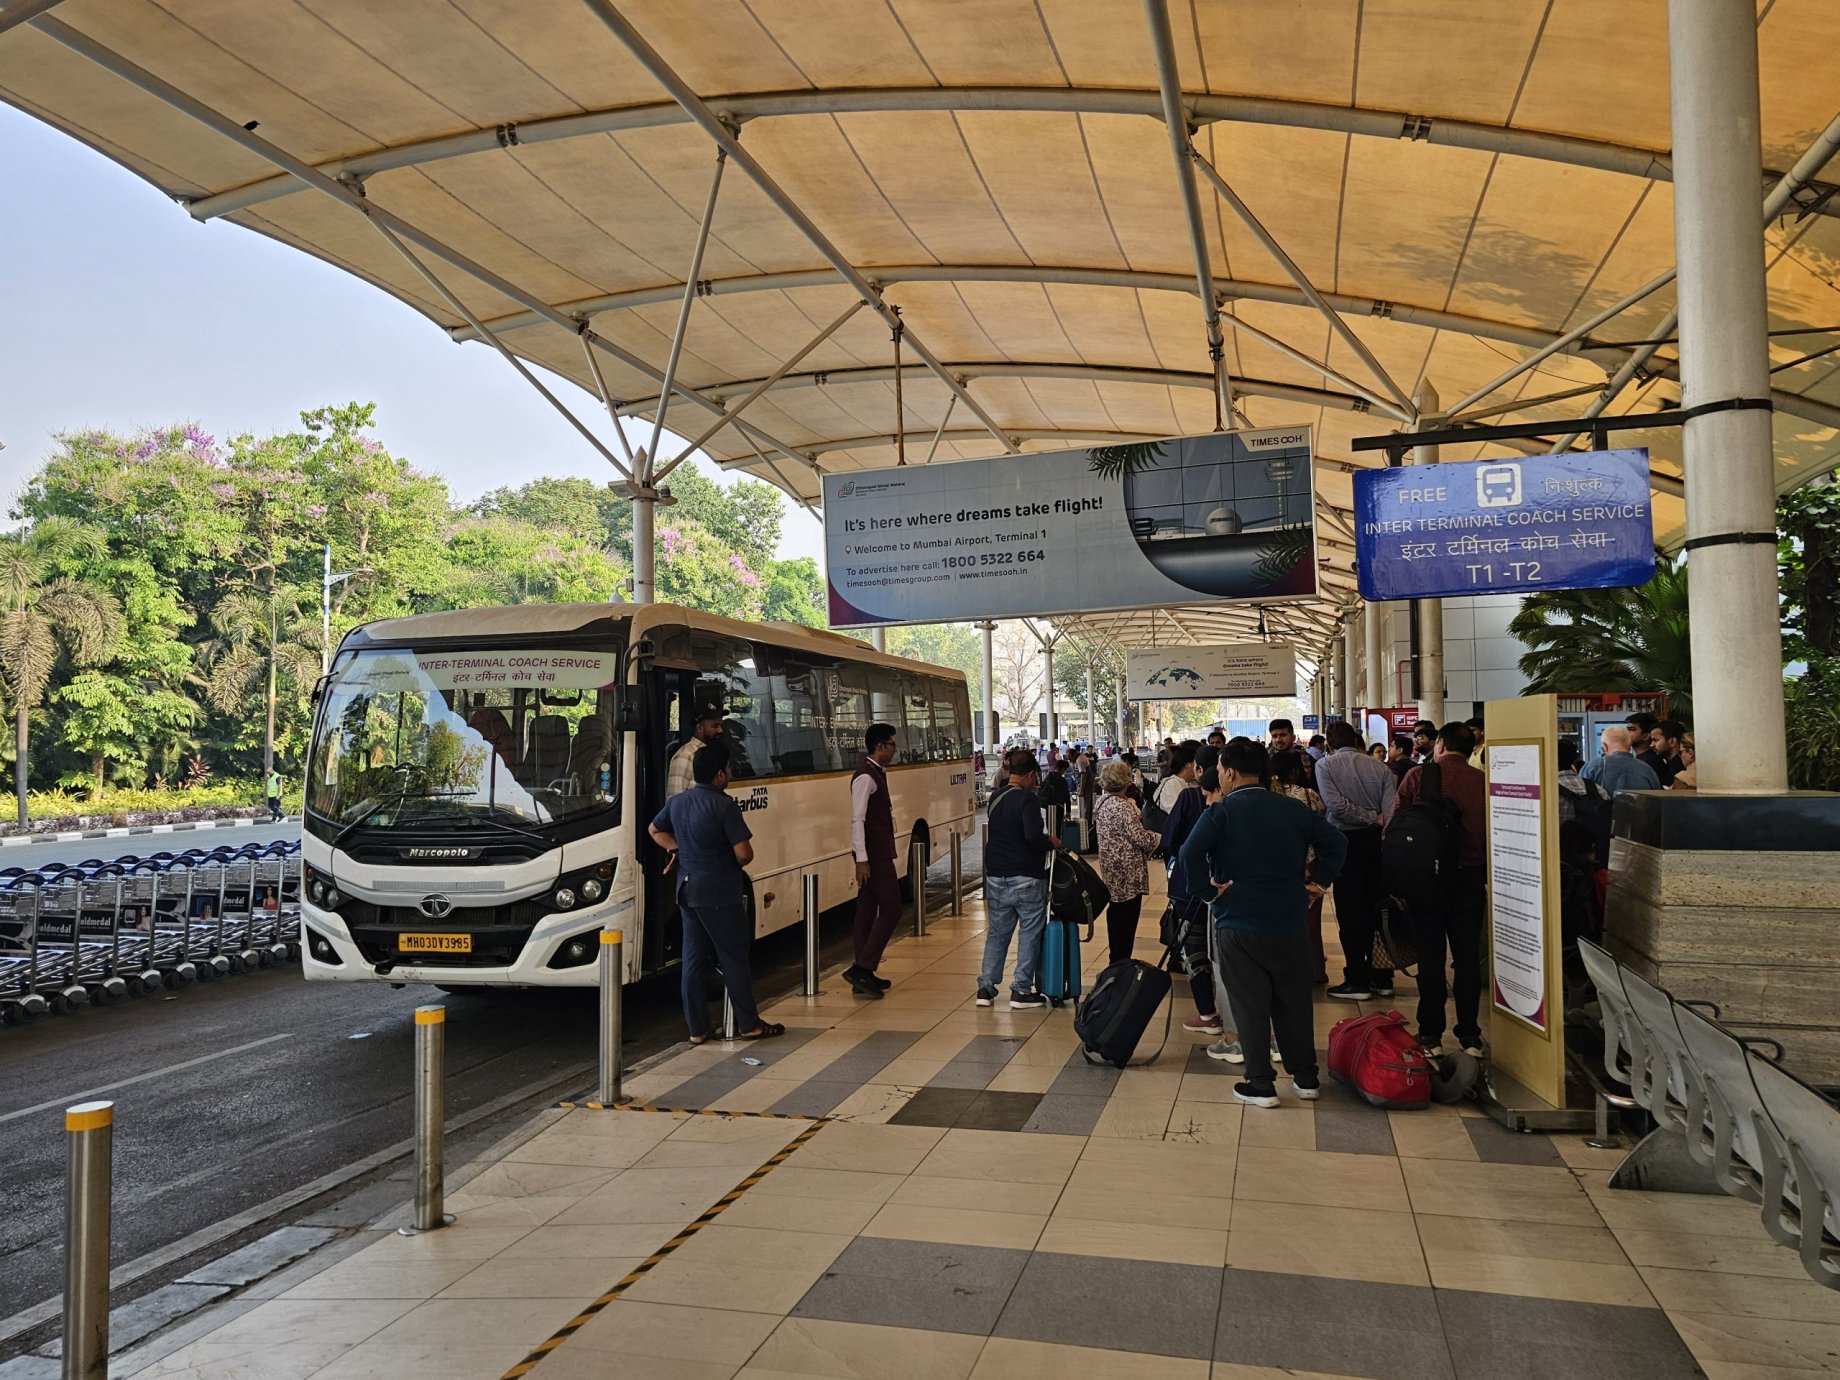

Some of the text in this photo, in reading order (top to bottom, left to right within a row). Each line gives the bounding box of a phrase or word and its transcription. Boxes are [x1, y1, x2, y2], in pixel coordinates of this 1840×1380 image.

[1251, 435, 1302, 447] TIMES OOH
[1399, 487, 1447, 505] FREE
[870, 517, 902, 530] here
[907, 513, 952, 526] where
[956, 506, 1011, 522] dreams
[1015, 502, 1050, 517] take
[1054, 496, 1103, 515] flight!
[1365, 504, 1645, 535] INTER TERMINAL COACH SERVICE
[854, 529, 1047, 555] Welcome to Mumbai Airport, Terminal 1
[1400, 527, 1607, 560] इंटर टर्मिनल कोच सेवा
[846, 549, 1045, 576] To advertise here call: 1800 5322 664
[846, 567, 1028, 588] timesooh@timesgroup.com www.timesooh.in
[1466, 563, 1493, 584] T1
[418, 657, 601, 670] INTER-TERMINAL COACH SERVICE
[512, 669, 532, 681] कोच
[537, 670, 556, 681] सेवा
[950, 773, 967, 786] ULTRA
[752, 787, 768, 796] TATA
[735, 795, 768, 812] tarbus
[409, 848, 468, 858] Marcopolo
[223, 896, 245, 904] dmedal
[39, 923, 72, 934] oldmedal
[80, 917, 111, 926] oldmedal
